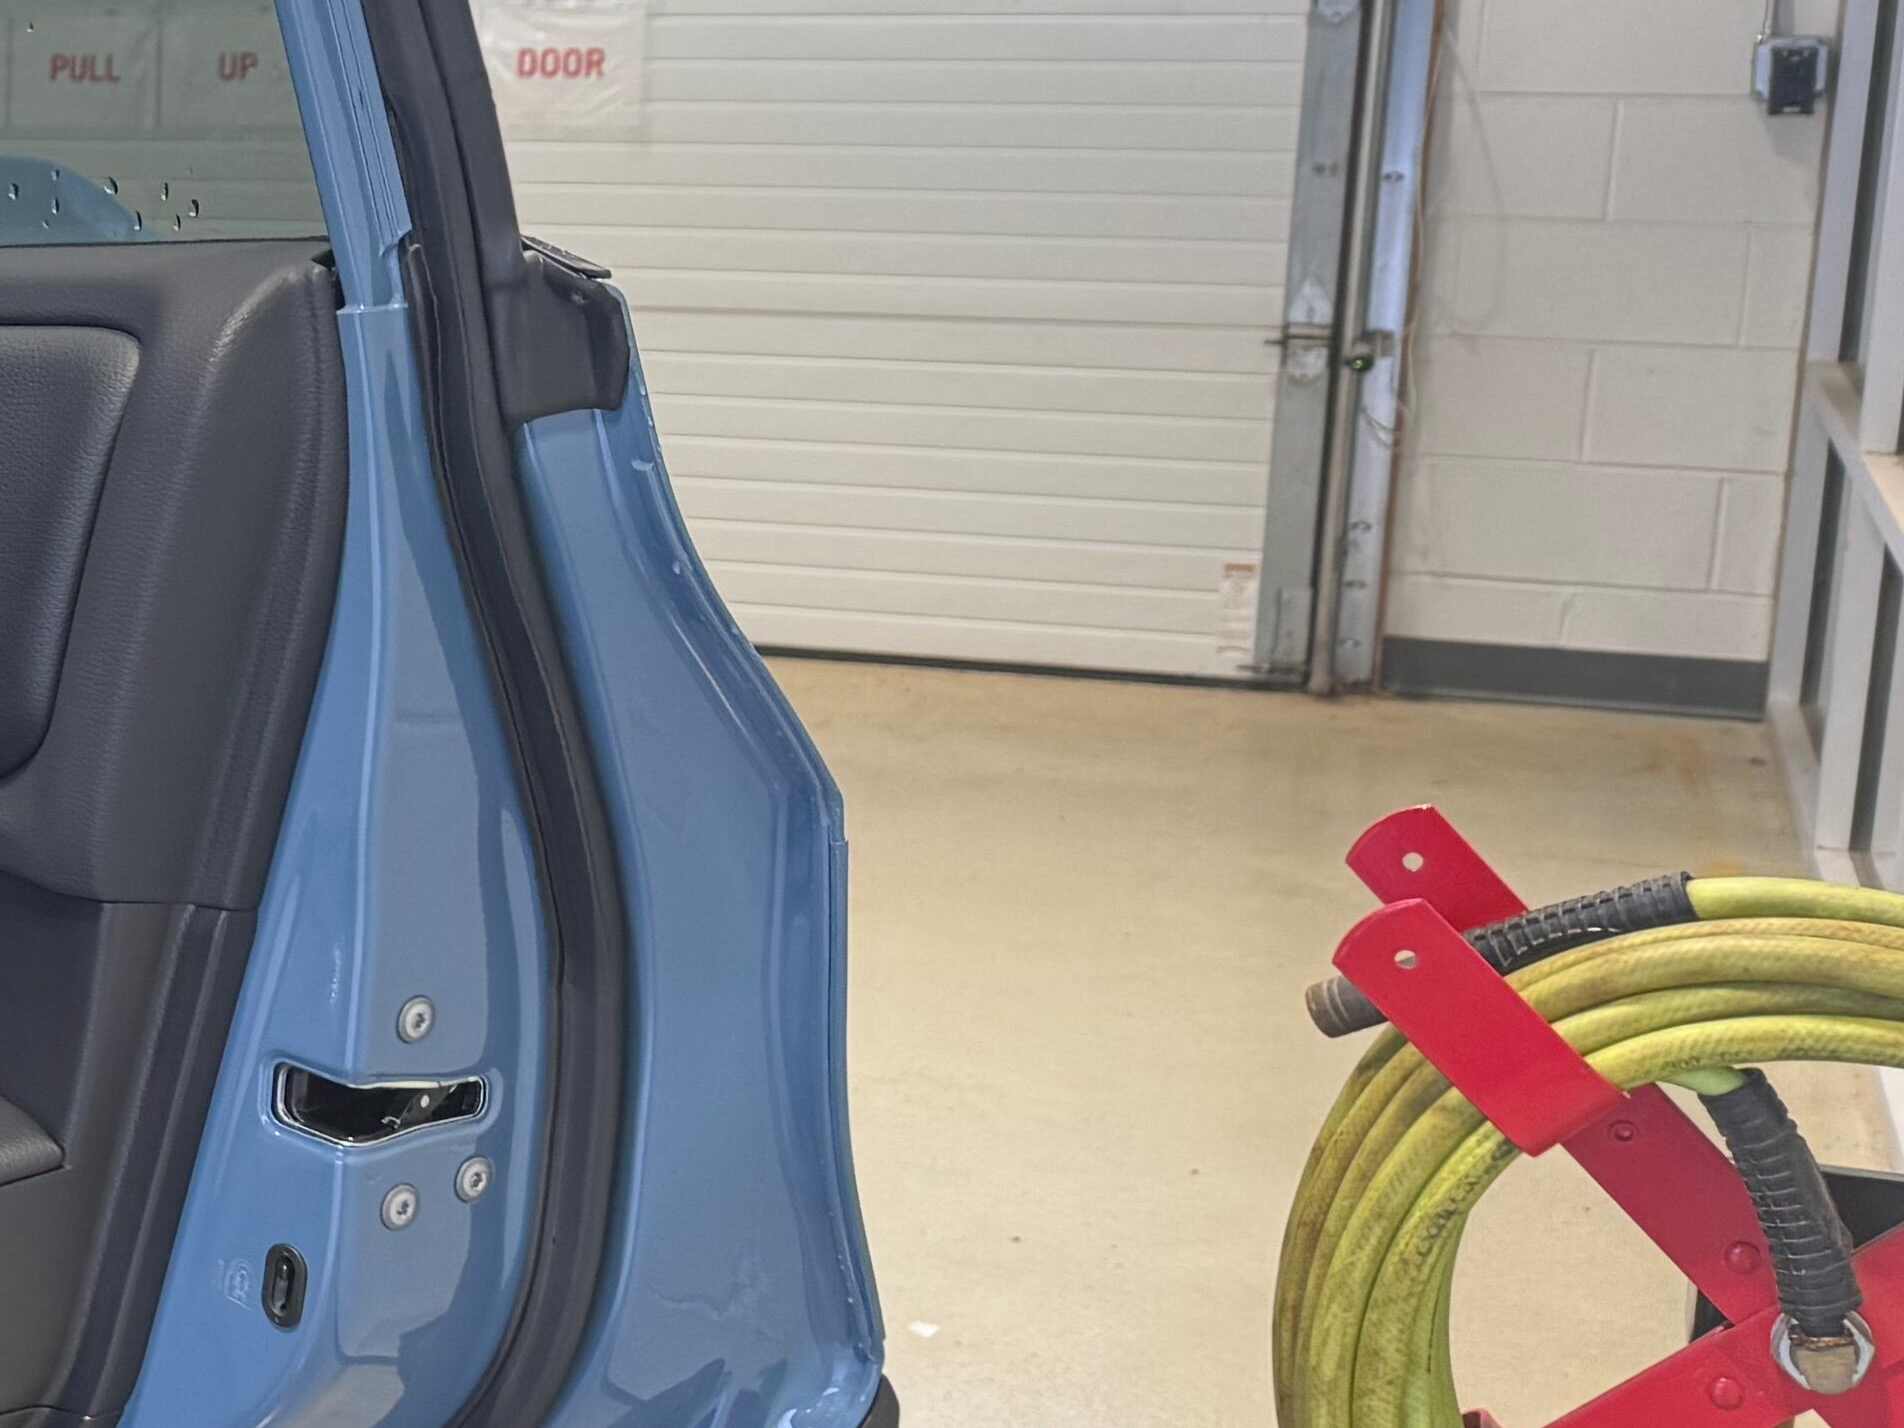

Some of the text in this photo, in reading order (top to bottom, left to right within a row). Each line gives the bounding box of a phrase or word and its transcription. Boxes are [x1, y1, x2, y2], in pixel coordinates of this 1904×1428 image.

[50, 53, 121, 83] PULL
[217, 51, 259, 81] UP
[517, 46, 607, 79] DOOR
